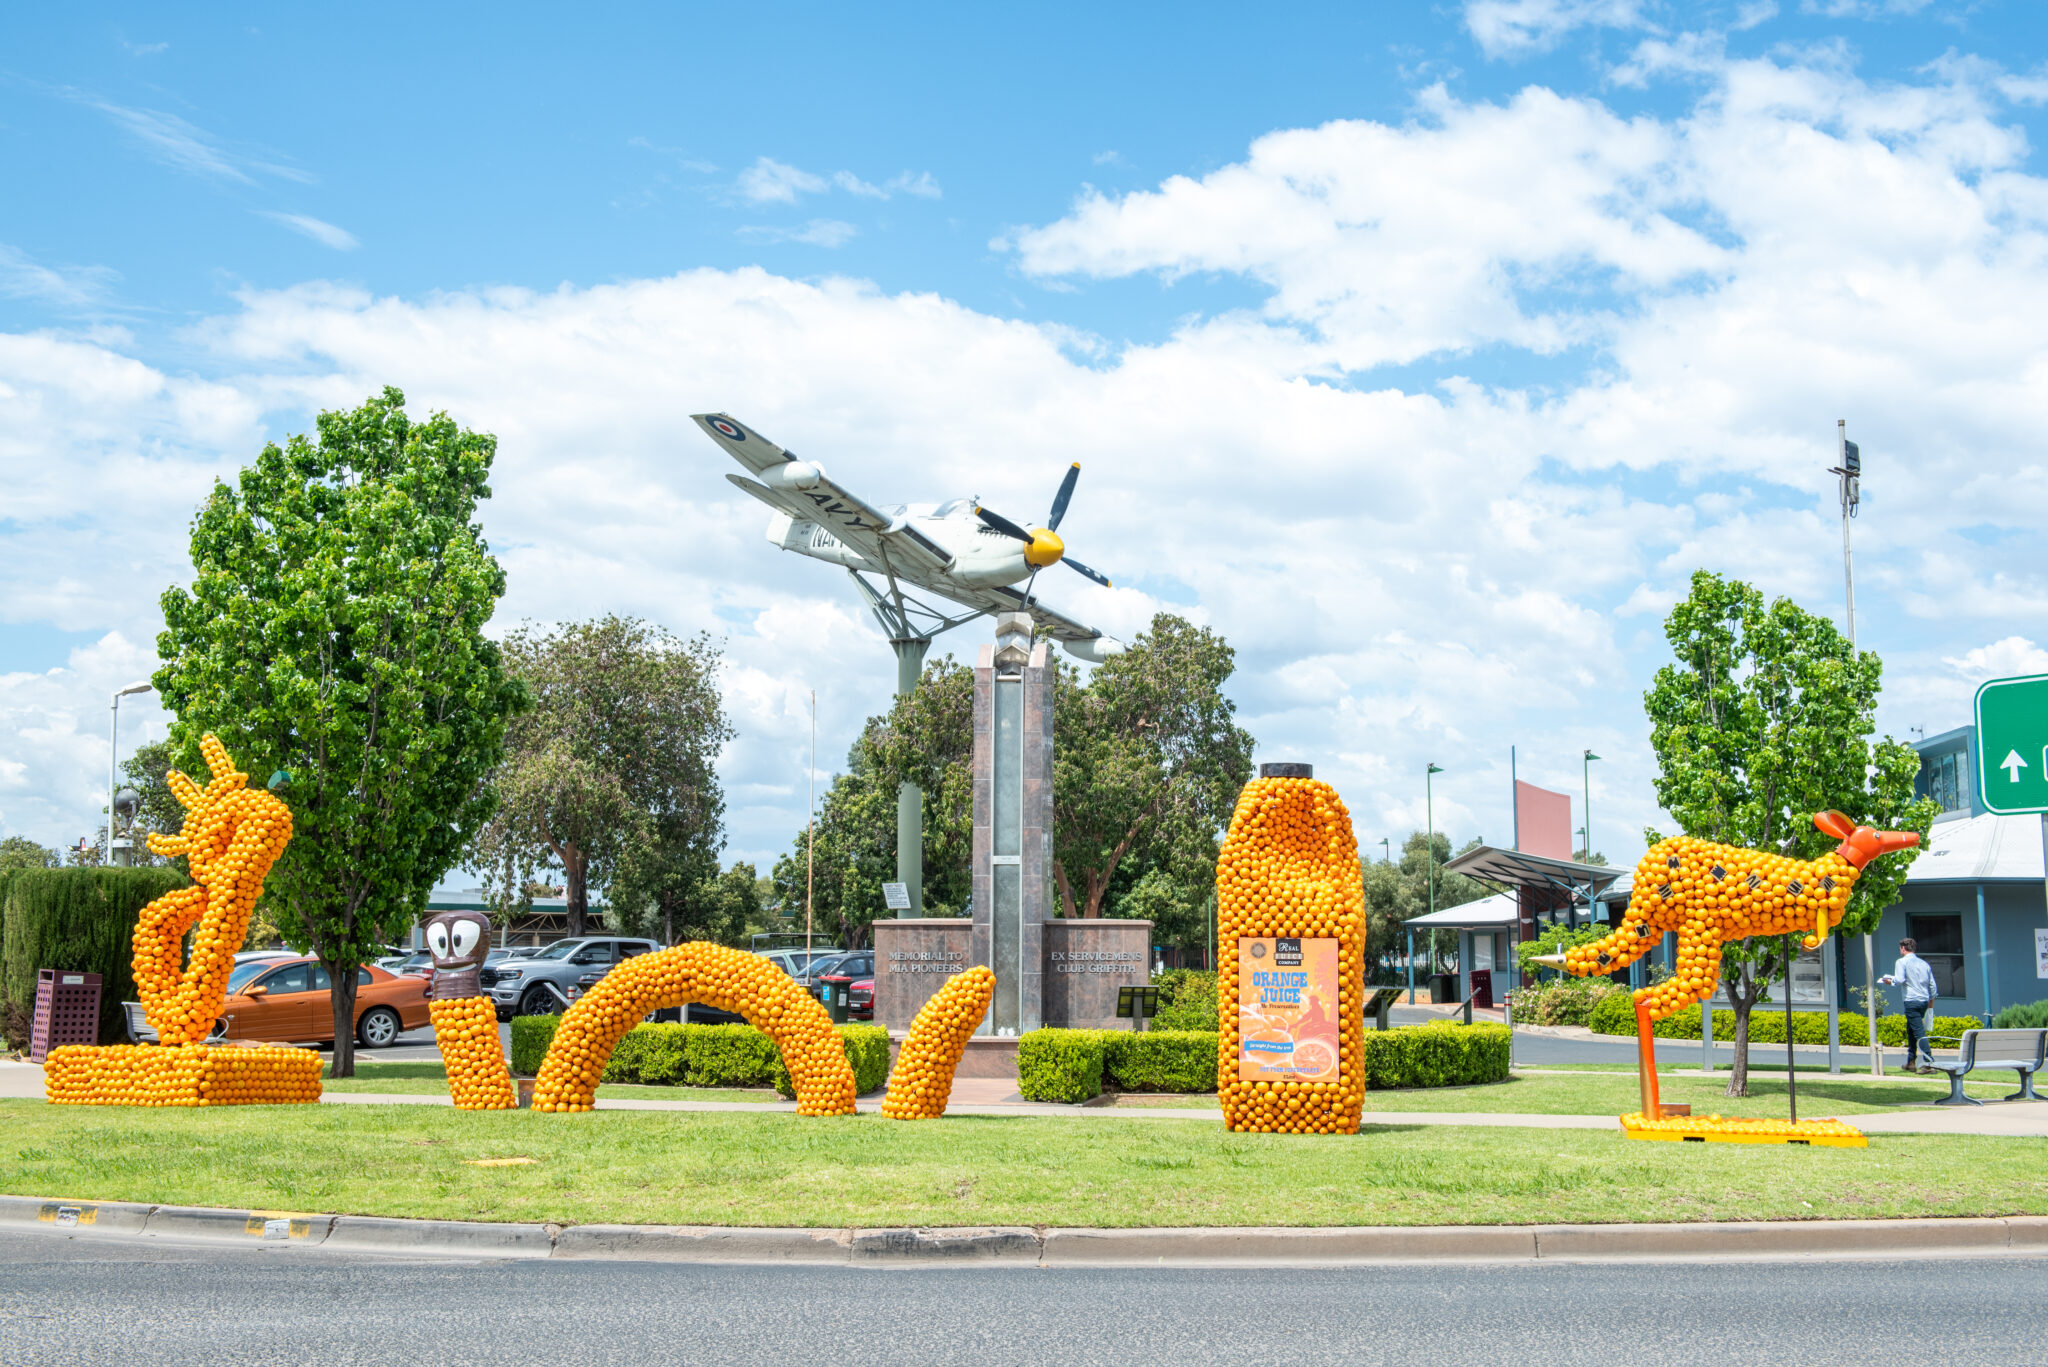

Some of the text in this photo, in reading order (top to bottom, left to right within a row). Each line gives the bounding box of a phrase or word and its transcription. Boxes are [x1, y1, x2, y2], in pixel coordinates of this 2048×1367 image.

[803, 486, 872, 528] AVY
[812, 526, 843, 548] NAV
[889, 951, 963, 961] MEMORIAL TO
[1051, 951, 1142, 961] EX SERVICEMENS
[888, 963, 963, 973] MIA PIONEERS
[1057, 964, 1137, 973] CLUB GRIFFITH
[1253, 971, 1308, 987] ORANGE
[1260, 988, 1301, 1003] JUICE
